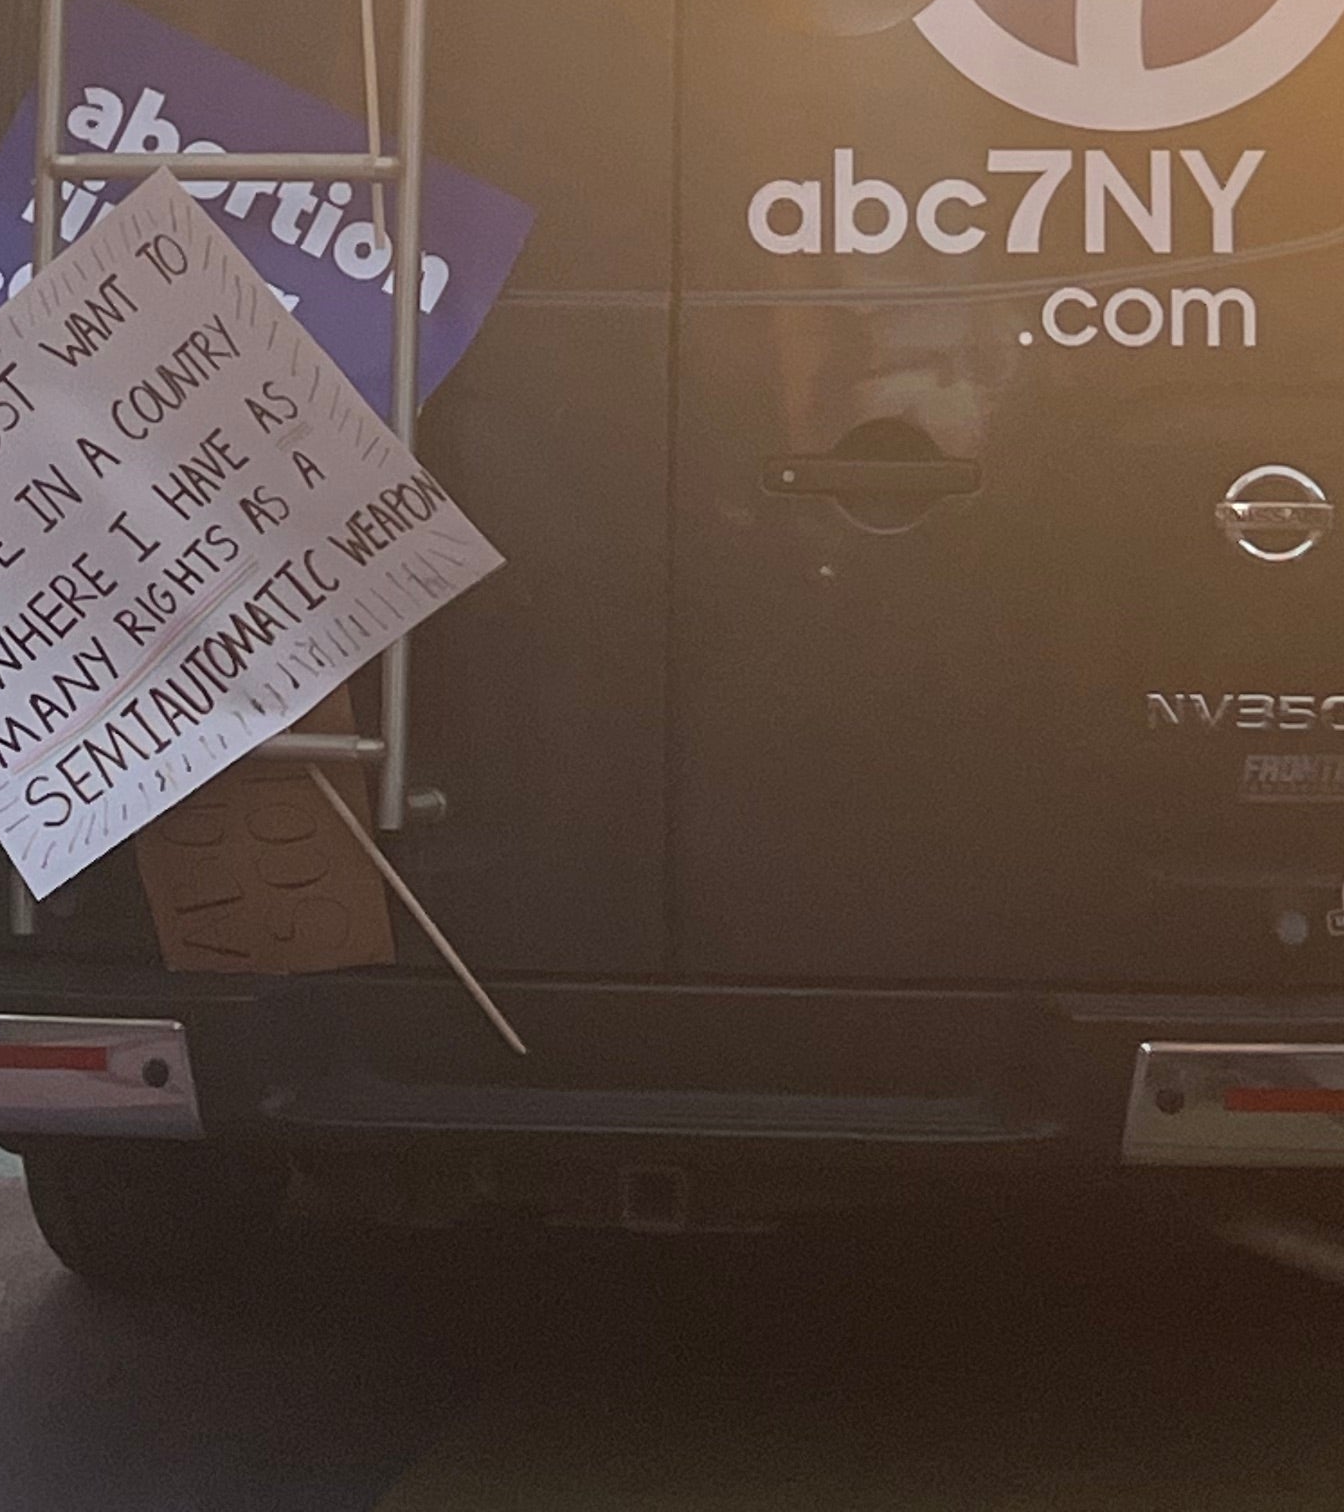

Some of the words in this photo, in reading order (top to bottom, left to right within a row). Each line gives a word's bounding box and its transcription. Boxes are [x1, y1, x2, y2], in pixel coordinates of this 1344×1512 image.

[66, 85, 452, 315] abortion
[747, 147, 1267, 255] abc7NY
[38, 272, 141, 370] WANT
[135, 233, 190, 286] TO
[1018, 285, 1258, 349] .com
[13, 463, 84, 536] IN
[75, 436, 124, 480] A
[110, 313, 244, 441] COUNTRY
[108, 511, 162, 567] I
[151, 427, 250, 522] HAVE
[251, 380, 300, 434] AS
[113, 524, 241, 648] RIGHTS
[238, 484, 292, 536] AS
[291, 448, 326, 491] A
[23, 548, 343, 829] SEMIAUTOMATIC
[327, 465, 446, 569] WEAPON
